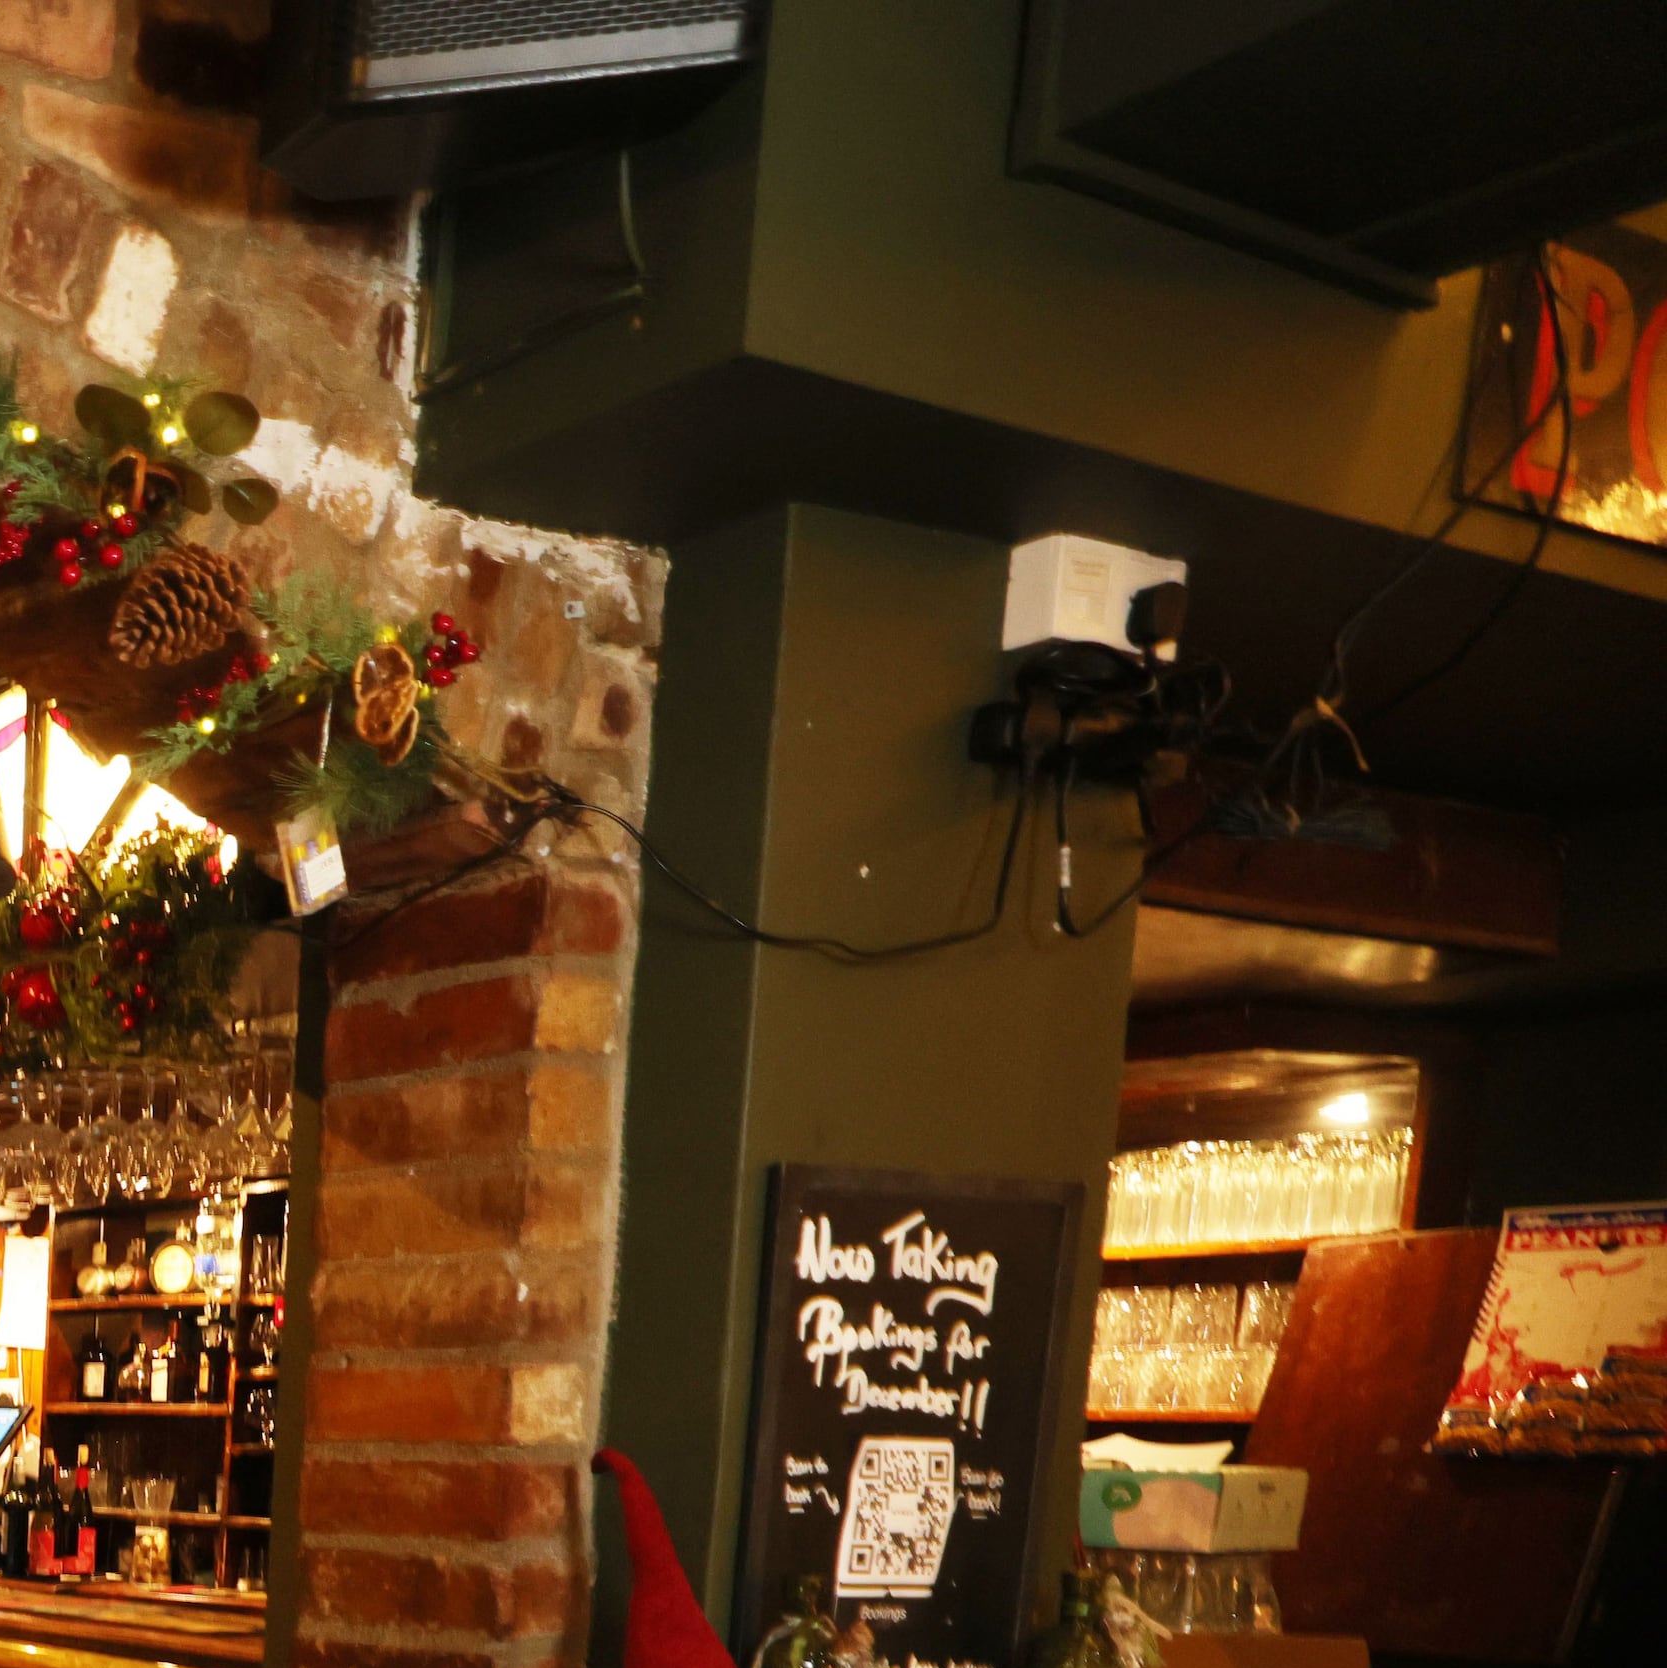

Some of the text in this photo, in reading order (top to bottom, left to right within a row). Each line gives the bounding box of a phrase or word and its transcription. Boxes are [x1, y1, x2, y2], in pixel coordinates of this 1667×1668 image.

[797, 1213, 875, 1283] Now
[945, 1319, 991, 1375] for
[860, 1606, 907, 1623] Bookings
